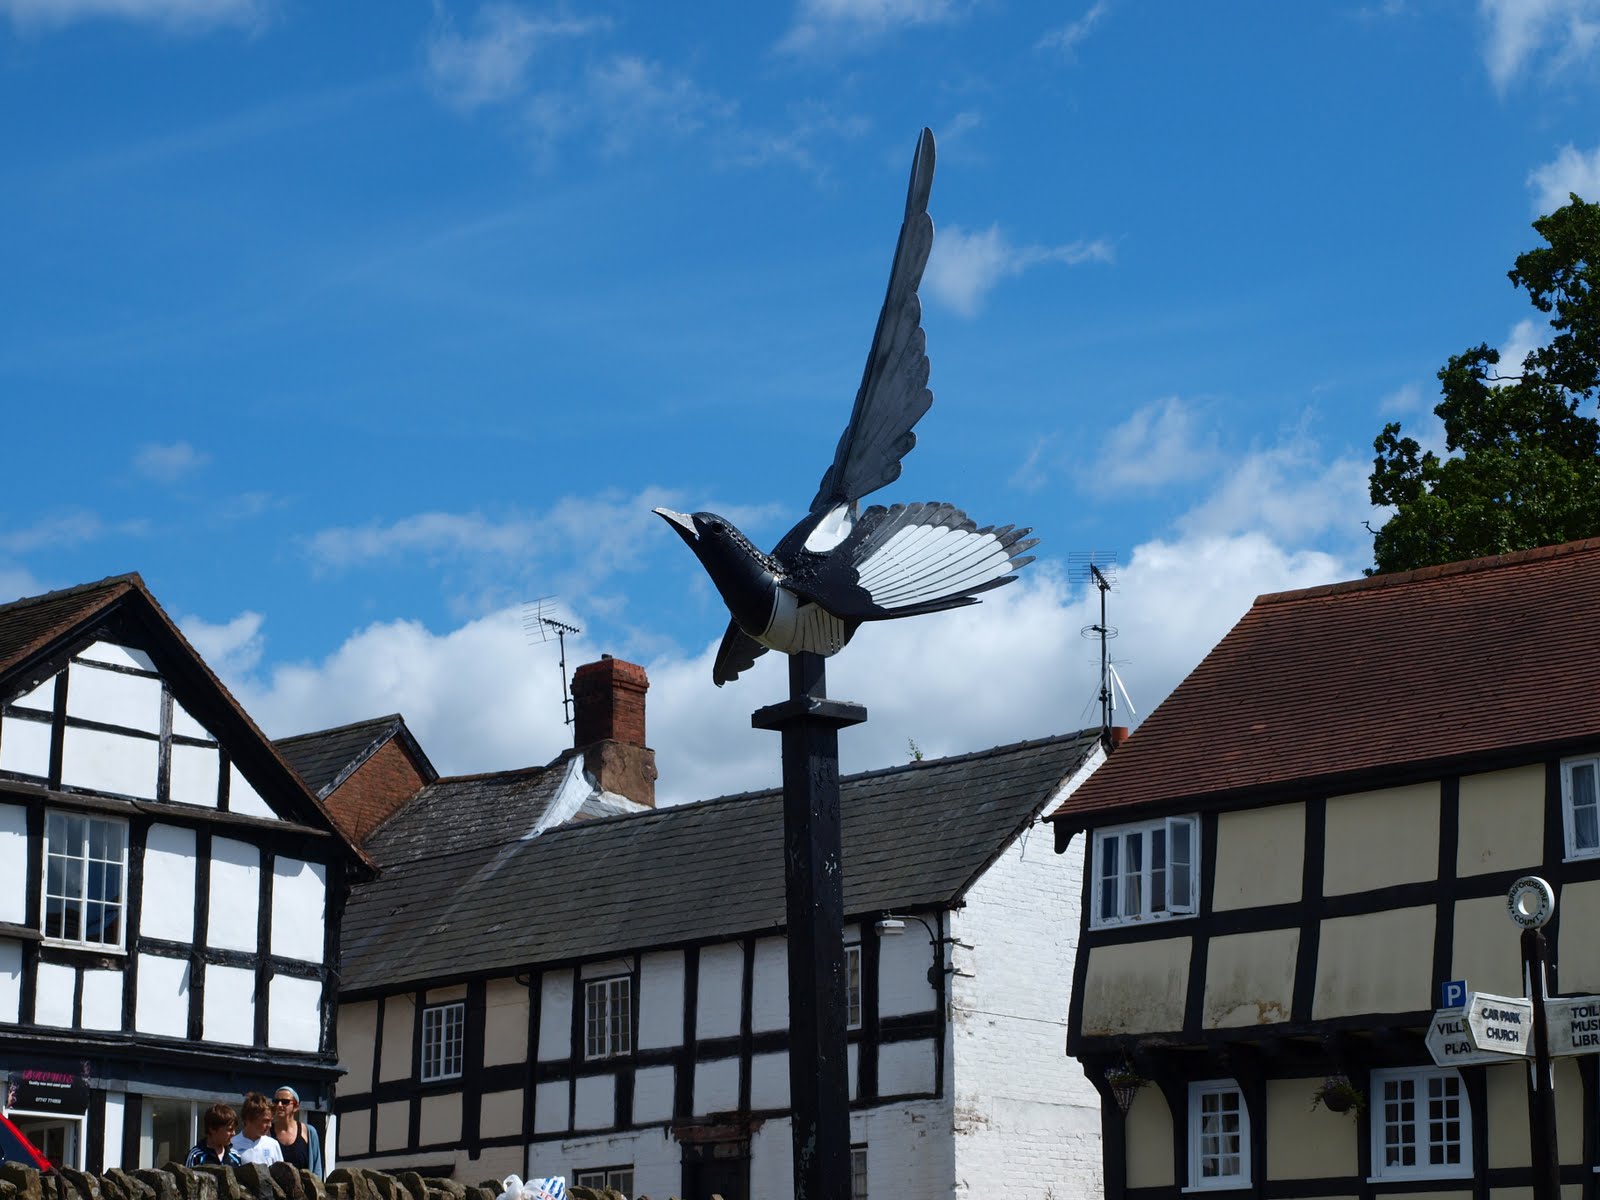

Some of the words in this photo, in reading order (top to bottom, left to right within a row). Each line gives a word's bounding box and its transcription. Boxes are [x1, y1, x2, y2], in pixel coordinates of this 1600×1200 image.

[1508, 880, 1547, 910] HEREFORDSHIRE
[1514, 910, 1544, 926] COUNTY
[1447, 985, 1462, 1006] P
[1481, 1007, 1498, 1020] CAR
[1500, 1010, 1521, 1025] PARK
[1571, 1005, 1600, 1019] TOIL
[1437, 1022, 1465, 1035] VILL
[1486, 1027, 1519, 1042] CHURCH
